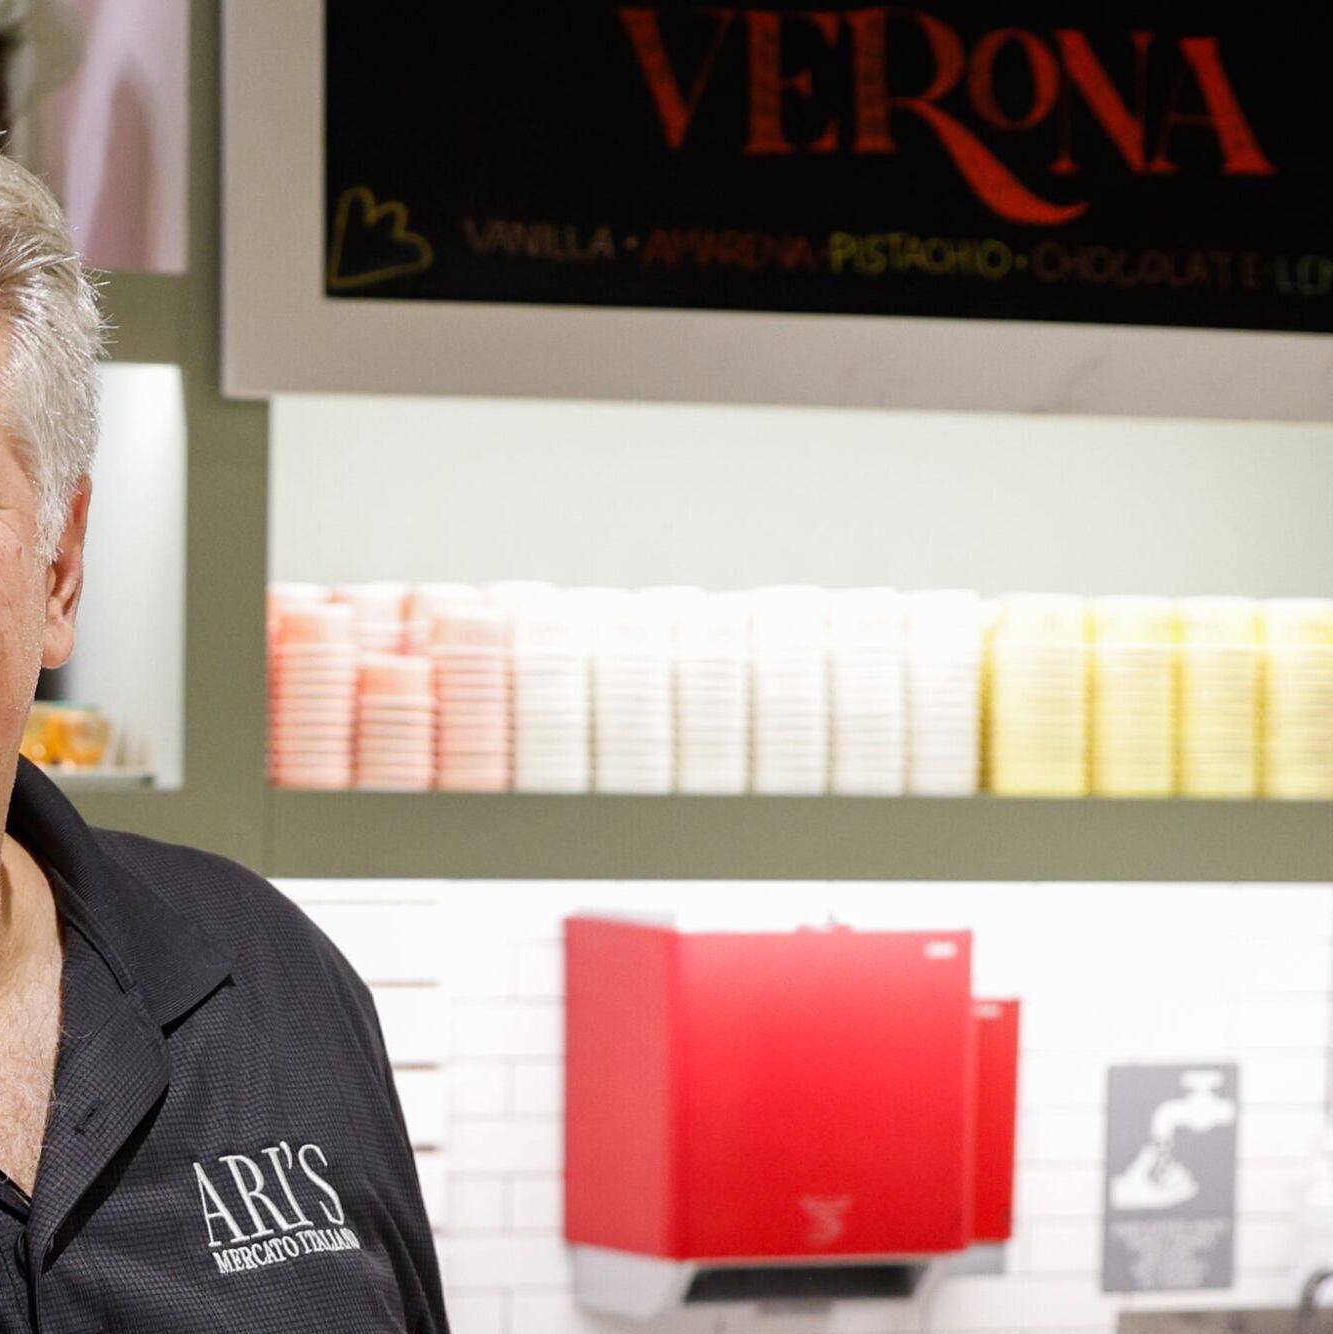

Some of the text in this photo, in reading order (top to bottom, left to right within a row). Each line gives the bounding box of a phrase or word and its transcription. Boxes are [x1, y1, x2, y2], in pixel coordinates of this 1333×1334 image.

[613, 6, 1279, 228] VERONA
[460, 215, 615, 263] VANILLA
[829, 229, 1013, 280] PISTACHIO
[1031, 238, 1262, 290] CHOCOLATE
[193, 1141, 345, 1247] ARI'S
[212, 1236, 300, 1275] MERCATO
